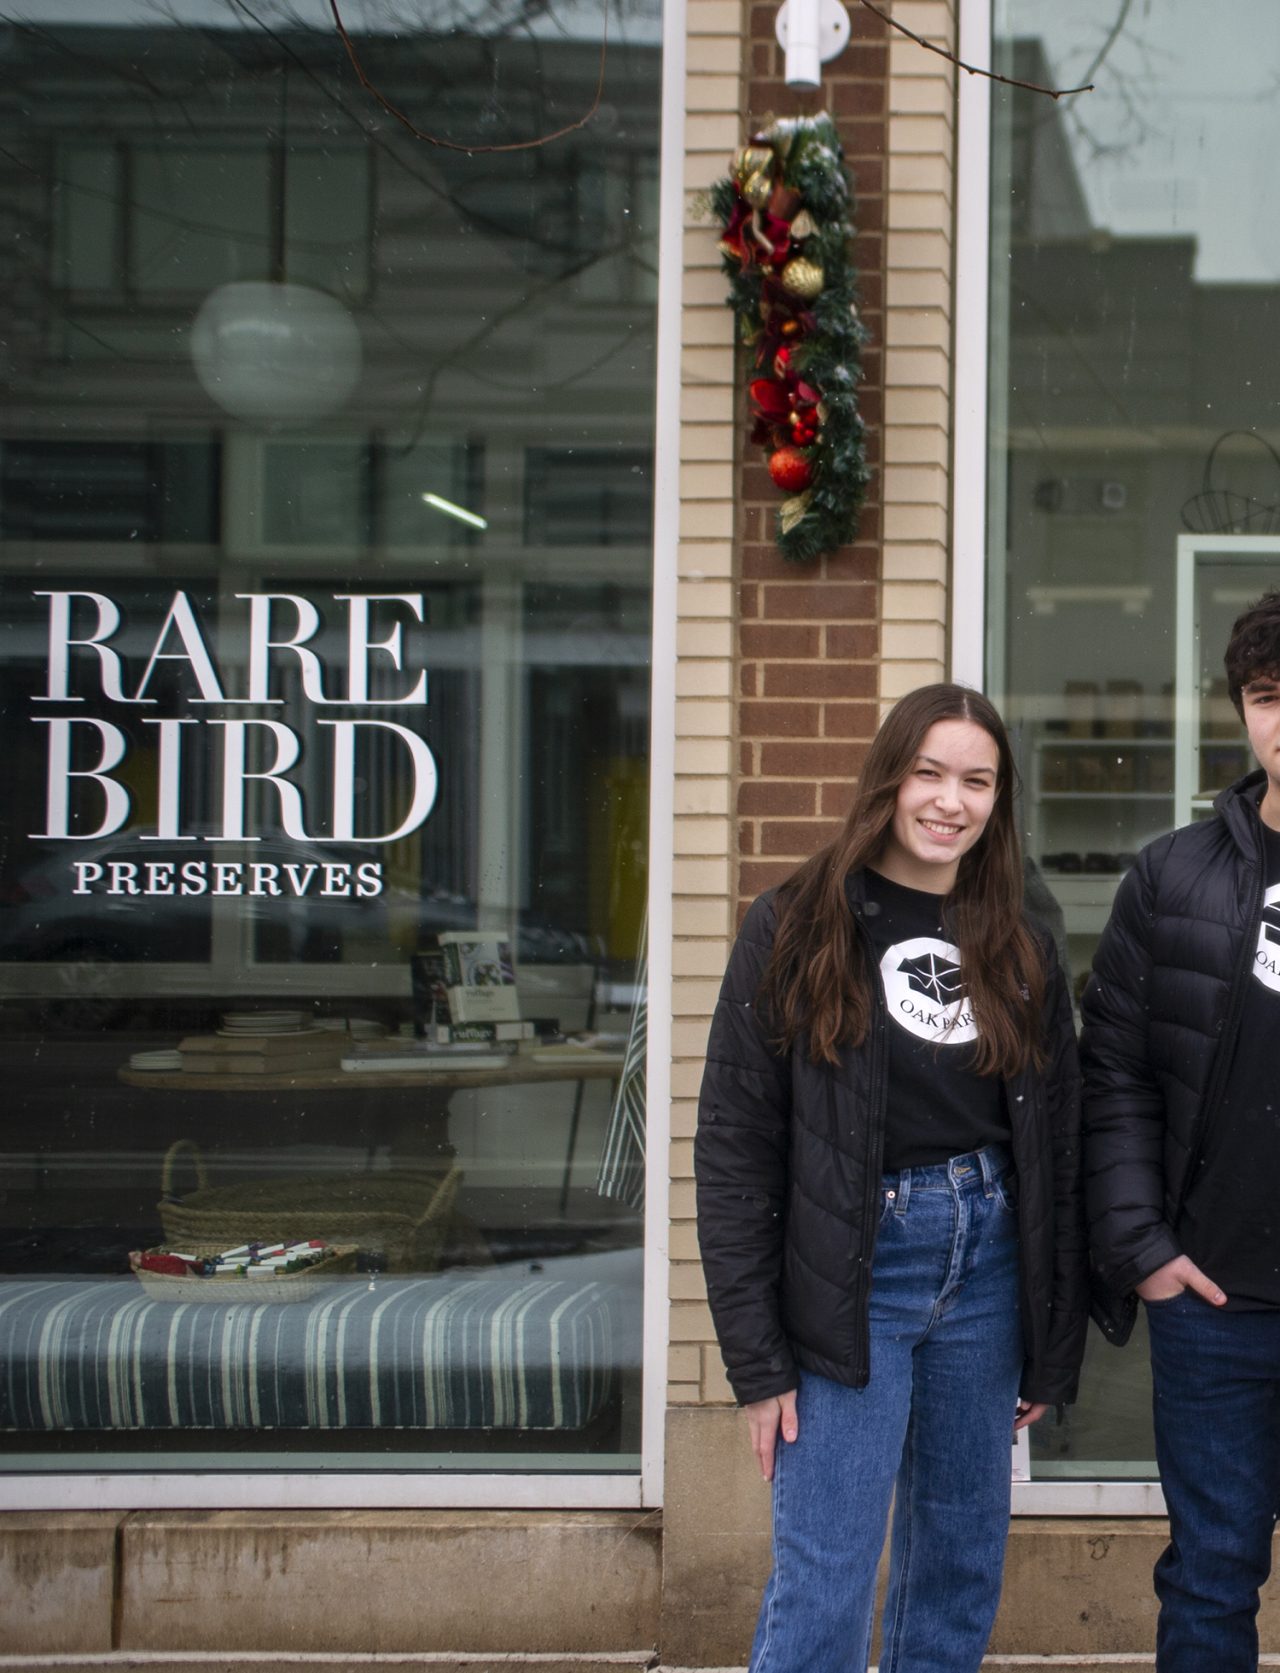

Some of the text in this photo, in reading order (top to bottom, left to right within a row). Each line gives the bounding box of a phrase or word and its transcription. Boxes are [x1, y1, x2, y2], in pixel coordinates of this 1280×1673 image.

[32, 592, 426, 704] RARE
[29, 718, 436, 842] BIRD
[74, 862, 381, 896] PRESERVES
[899, 999, 976, 1030] OAK PAR
